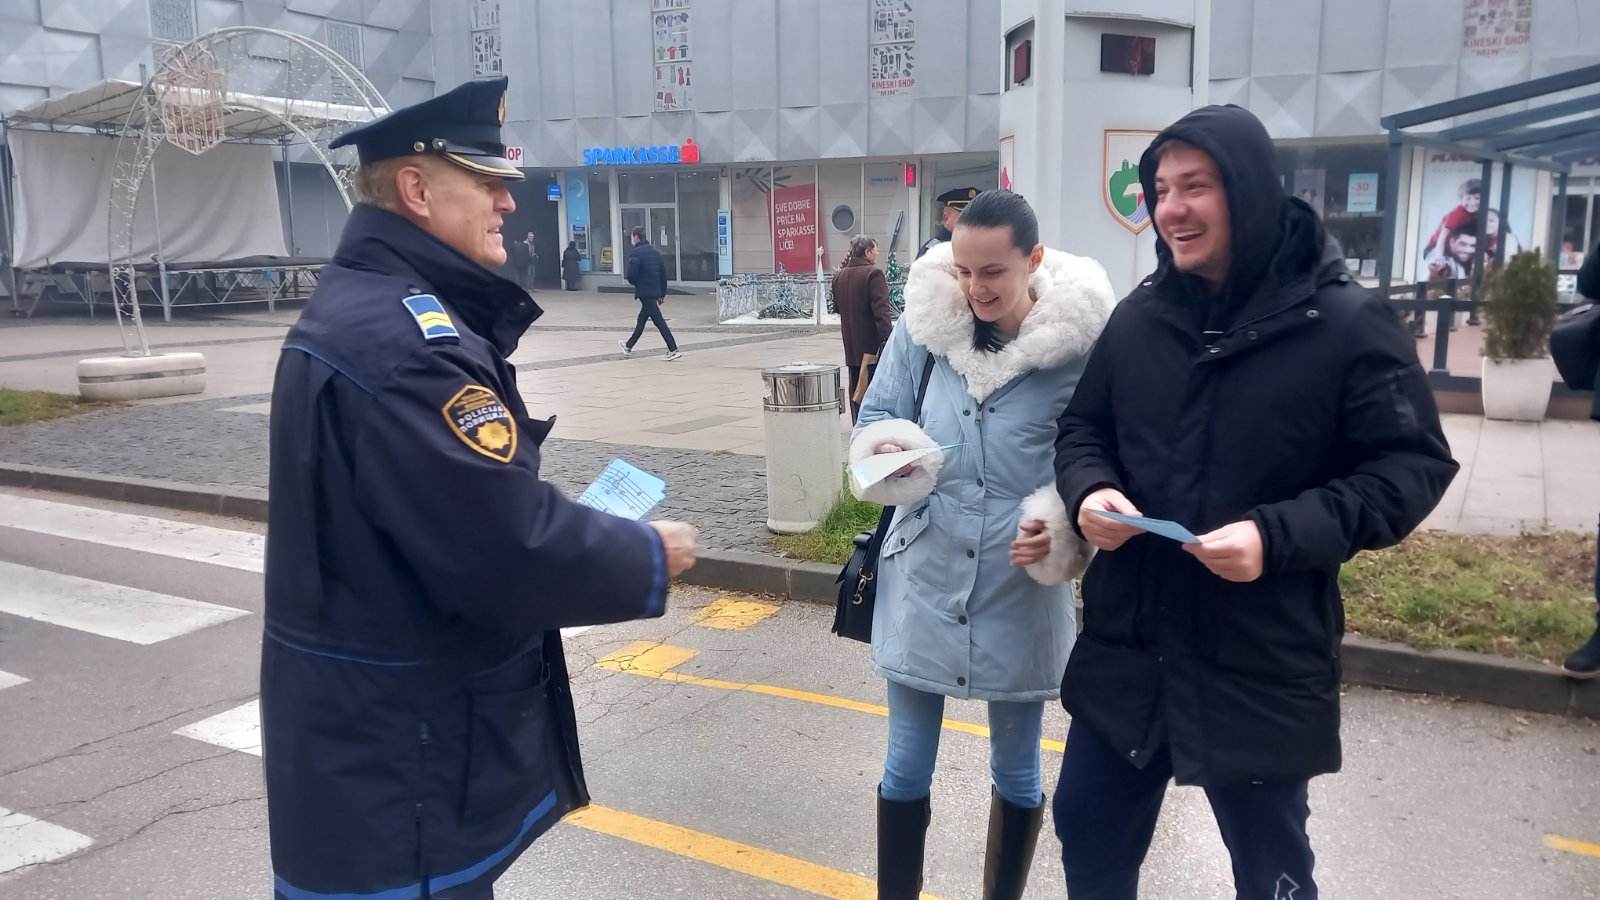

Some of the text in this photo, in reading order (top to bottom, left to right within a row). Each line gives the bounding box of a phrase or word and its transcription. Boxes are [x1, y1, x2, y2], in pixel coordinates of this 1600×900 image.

[504, 148, 521, 161] OP
[583, 145, 679, 165] SPARKASSE
[775, 199, 811, 213] SVE DOBRE
[795, 215, 805, 224] NA
[778, 224, 815, 238] SPARKASSE
